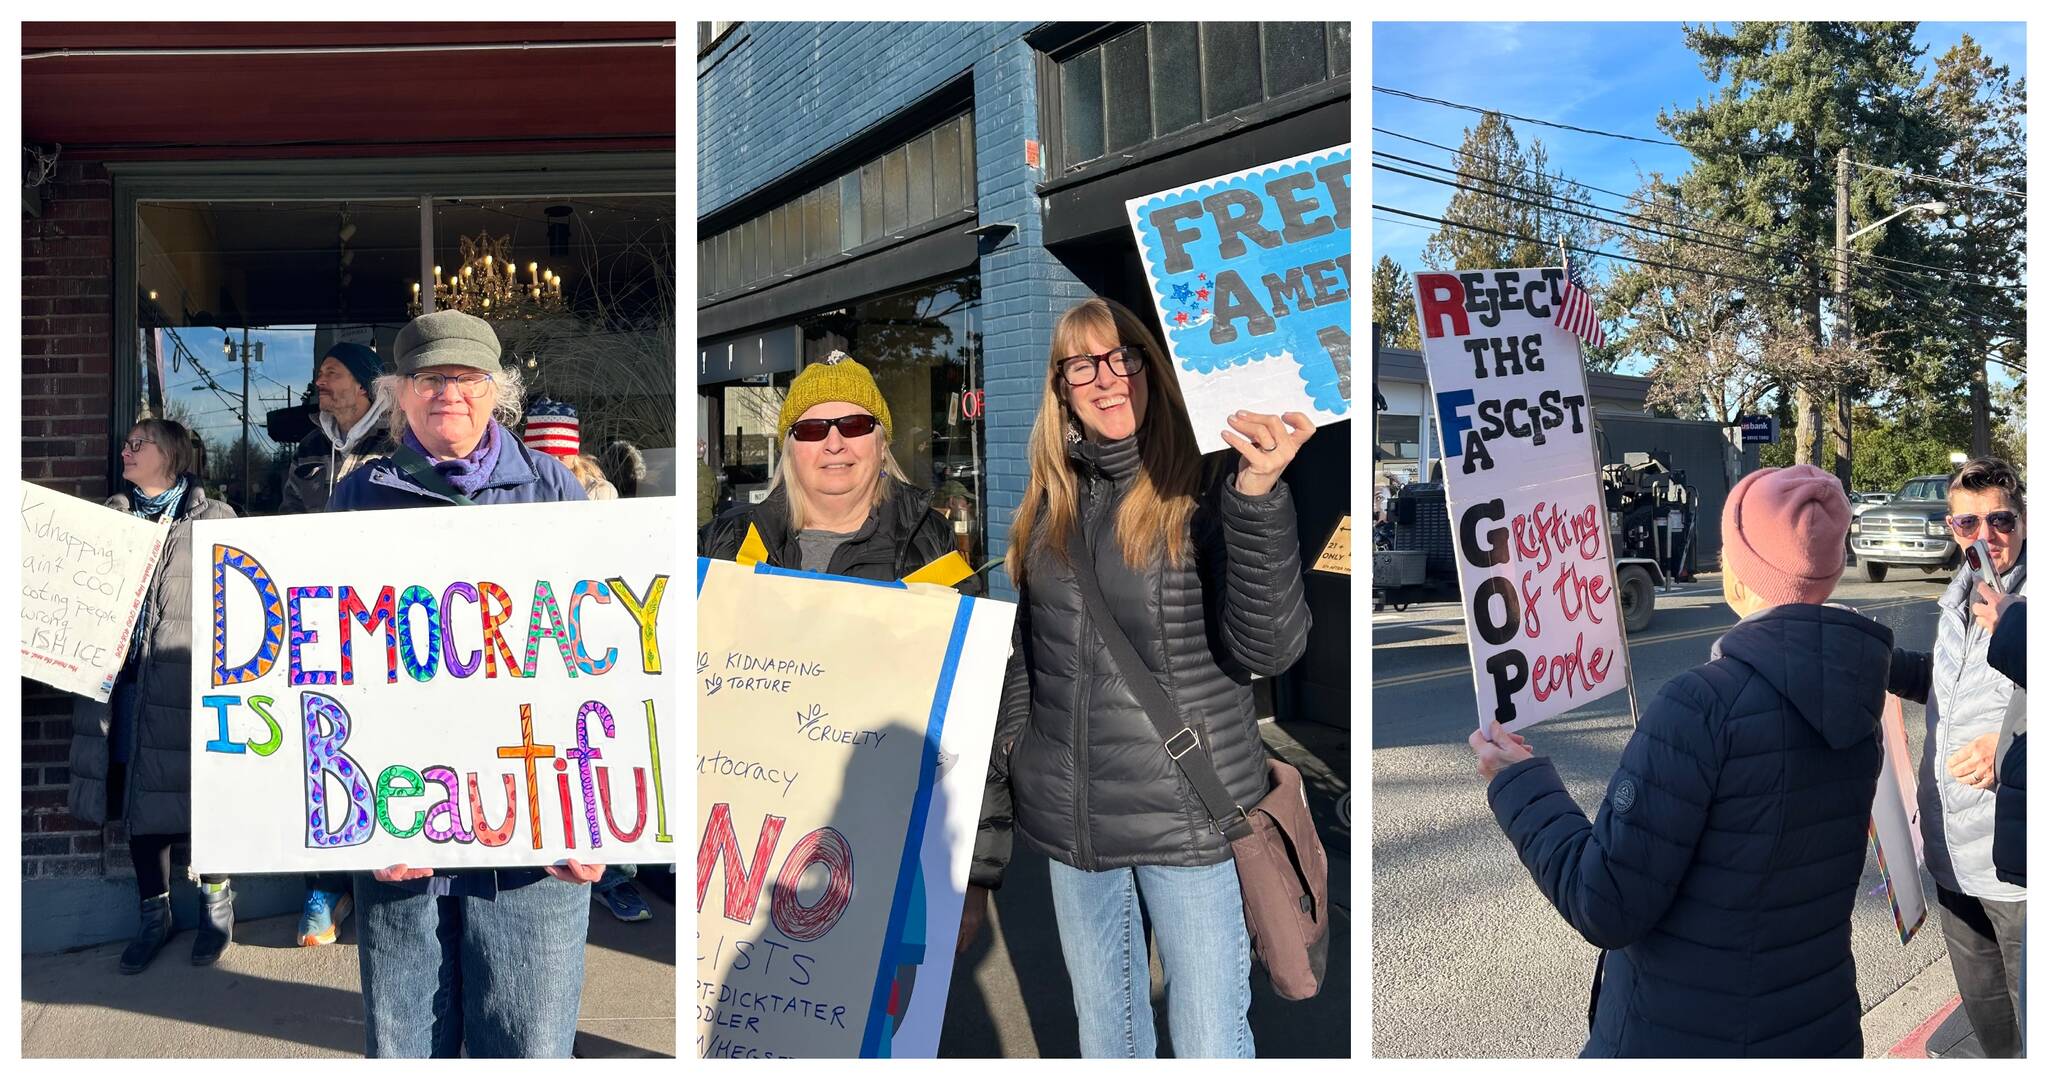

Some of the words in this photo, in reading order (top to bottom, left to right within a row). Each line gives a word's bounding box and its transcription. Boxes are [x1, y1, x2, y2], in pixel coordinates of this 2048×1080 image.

[1417, 269, 1563, 338] REJECT
[1464, 333, 1544, 378] THE
[1437, 389, 1585, 474] FASCIST
[21, 490, 113, 575] Kidnapping
[1322, 552, 1345, 560] ONLY
[212, 544, 670, 688] DEMOCRACY
[1553, 562, 1612, 624] the
[21, 607, 71, 640] wrong
[21, 628, 67, 655] ISH
[74, 640, 106, 667] ICE
[705, 673, 722, 690] NO
[727, 677, 791, 692] TORTURE
[726, 652, 825, 677] KIDNAPPING
[1486, 632, 1614, 724] People
[797, 704, 822, 725] NO
[808, 726, 886, 748] CRUELTY
[202, 695, 283, 756] IS
[300, 690, 673, 850] Beautiful
[697, 803, 854, 942] NO
[697, 931, 815, 985] ISTS
